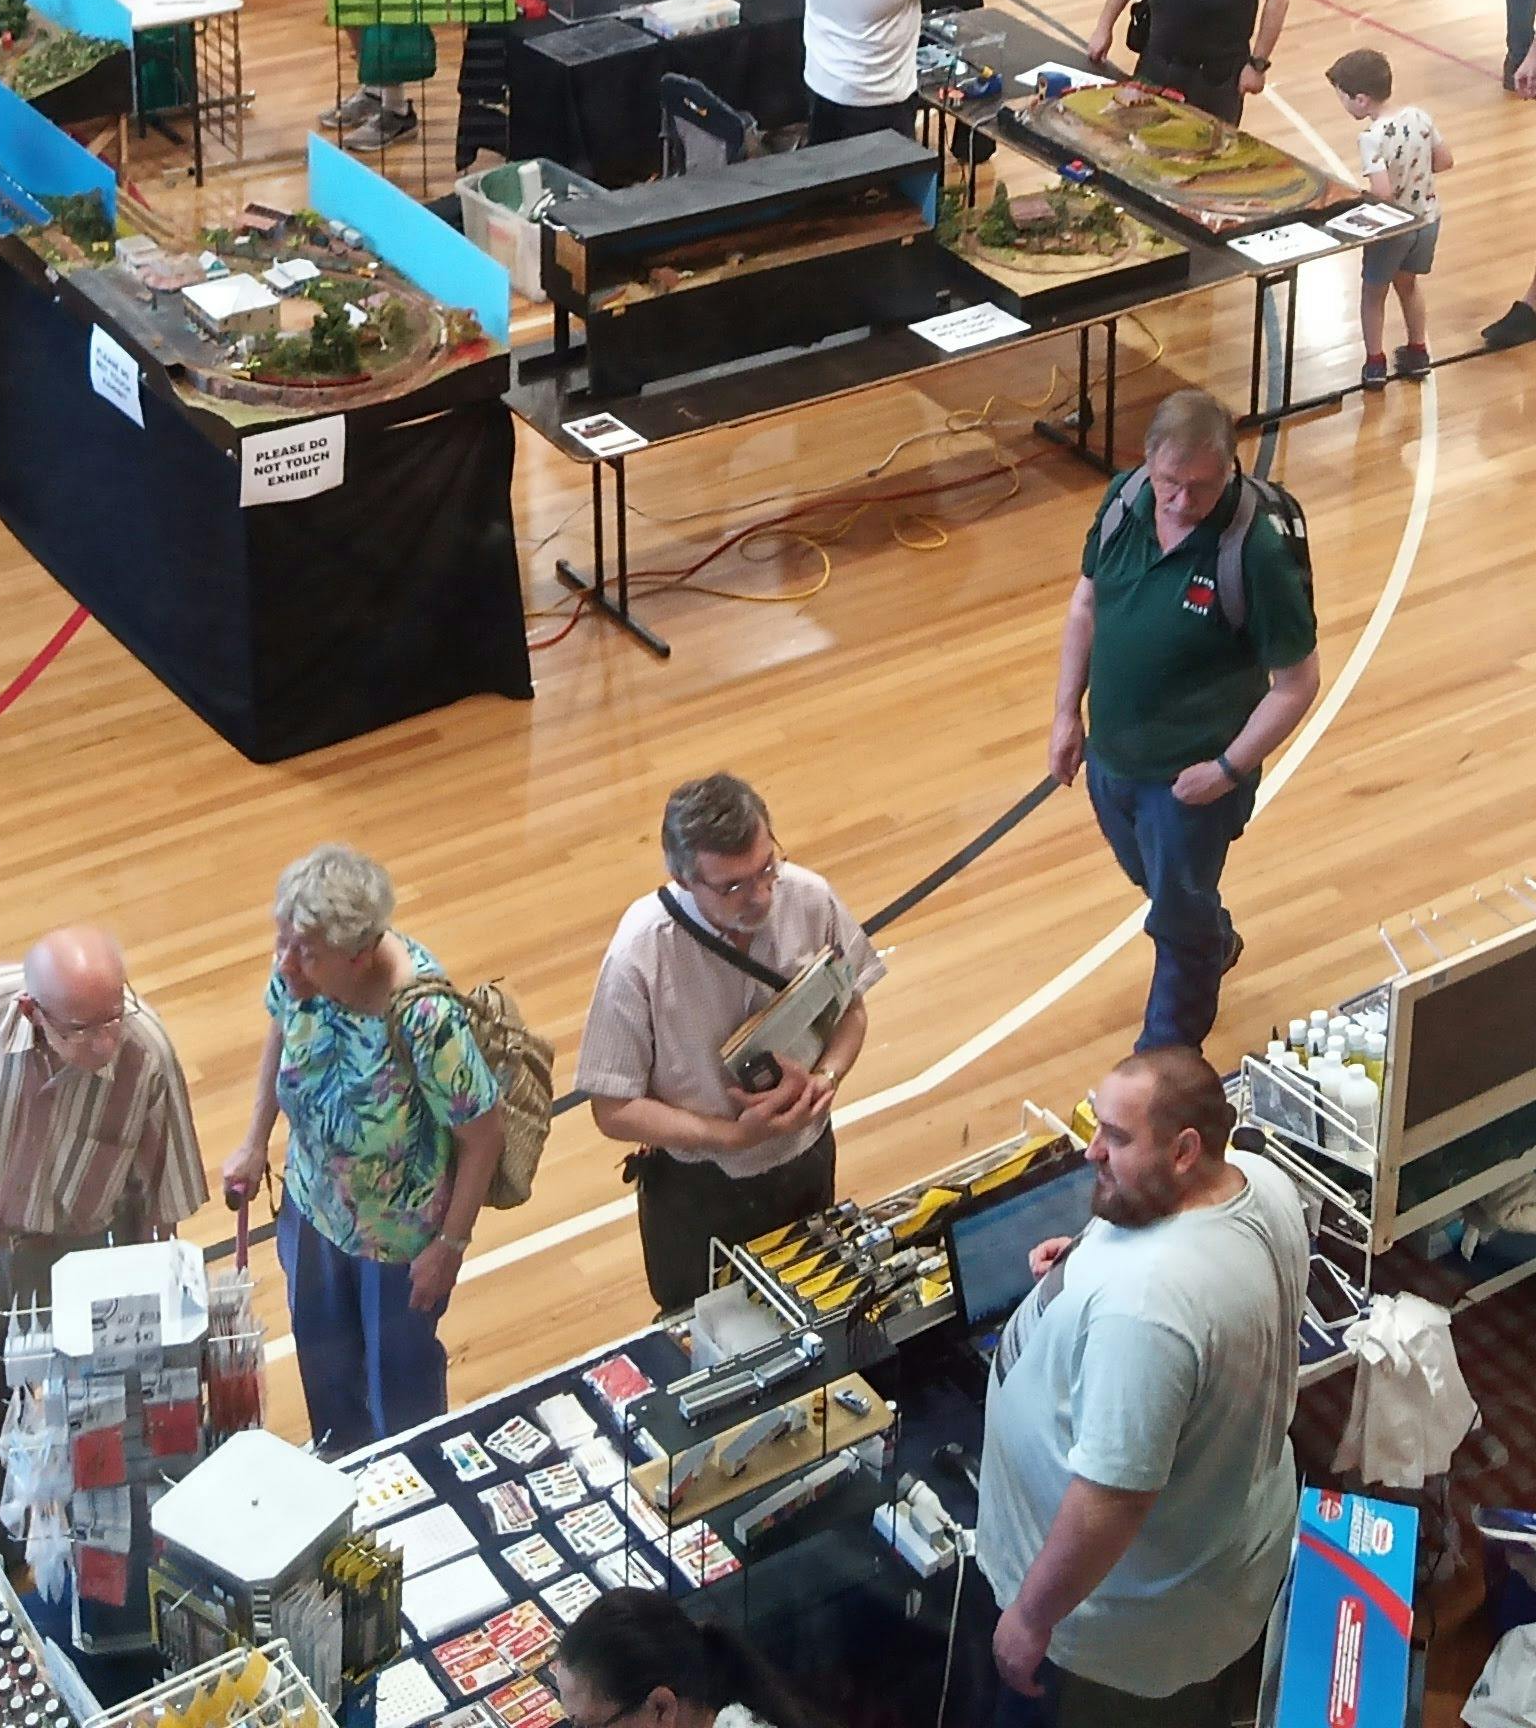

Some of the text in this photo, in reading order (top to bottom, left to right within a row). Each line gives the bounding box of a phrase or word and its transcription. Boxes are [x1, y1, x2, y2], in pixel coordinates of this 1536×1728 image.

[256, 437, 328, 462] PLEASE DO
[253, 450, 330, 476] NOT TOUCH
[267, 466, 321, 487] EXHIBIT
